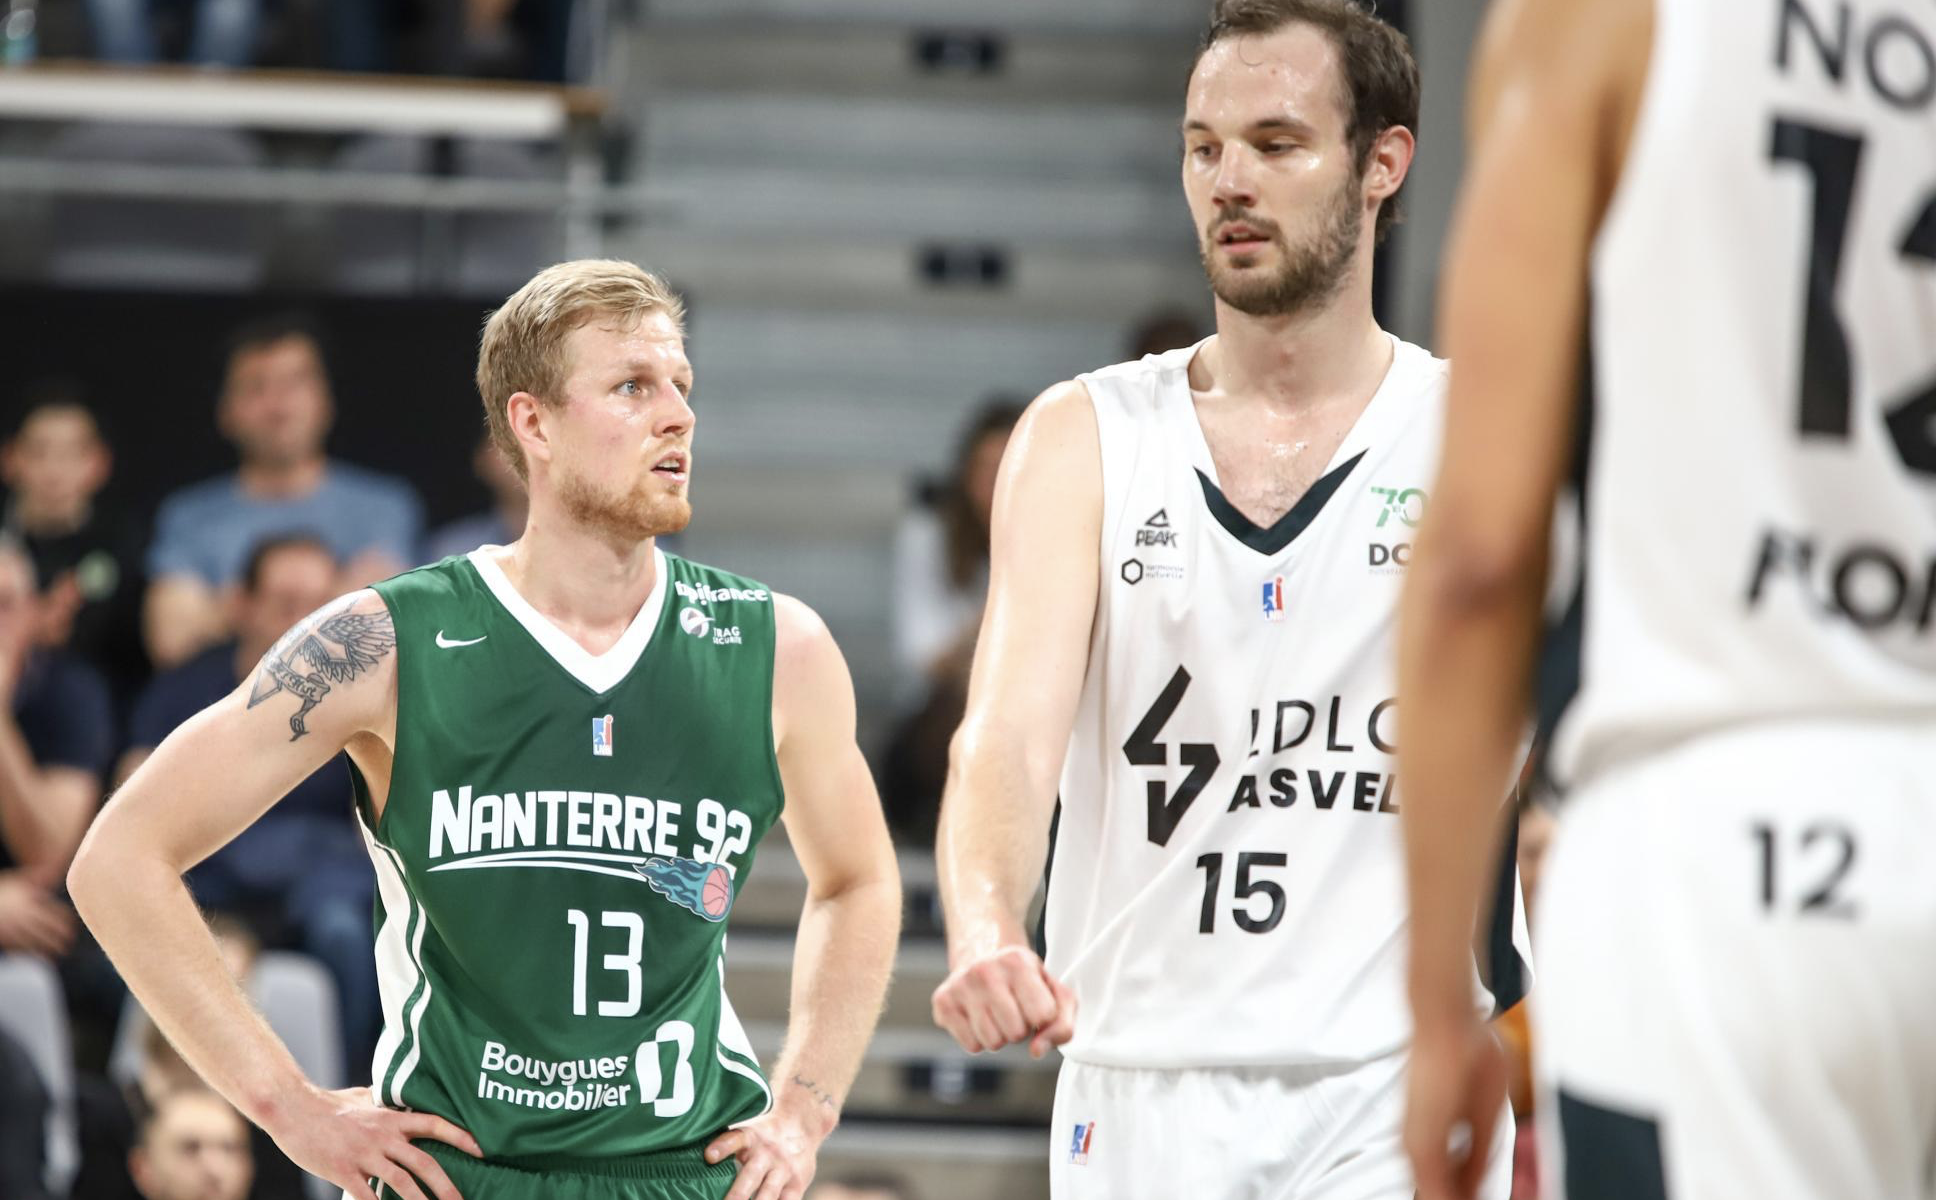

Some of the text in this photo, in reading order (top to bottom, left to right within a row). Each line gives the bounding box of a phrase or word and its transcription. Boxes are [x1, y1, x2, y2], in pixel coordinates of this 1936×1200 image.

[1135, 529, 1178, 549] PEAK
[1226, 767, 1400, 816] ASVEL
[428, 785, 752, 881] NANTERRE 92
[1196, 851, 1288, 935] 15
[1747, 818, 1858, 918] 12
[567, 908, 645, 1018] 13
[477, 1071, 632, 1112] Immobilier
[480, 1040, 629, 1085] Bouygues
